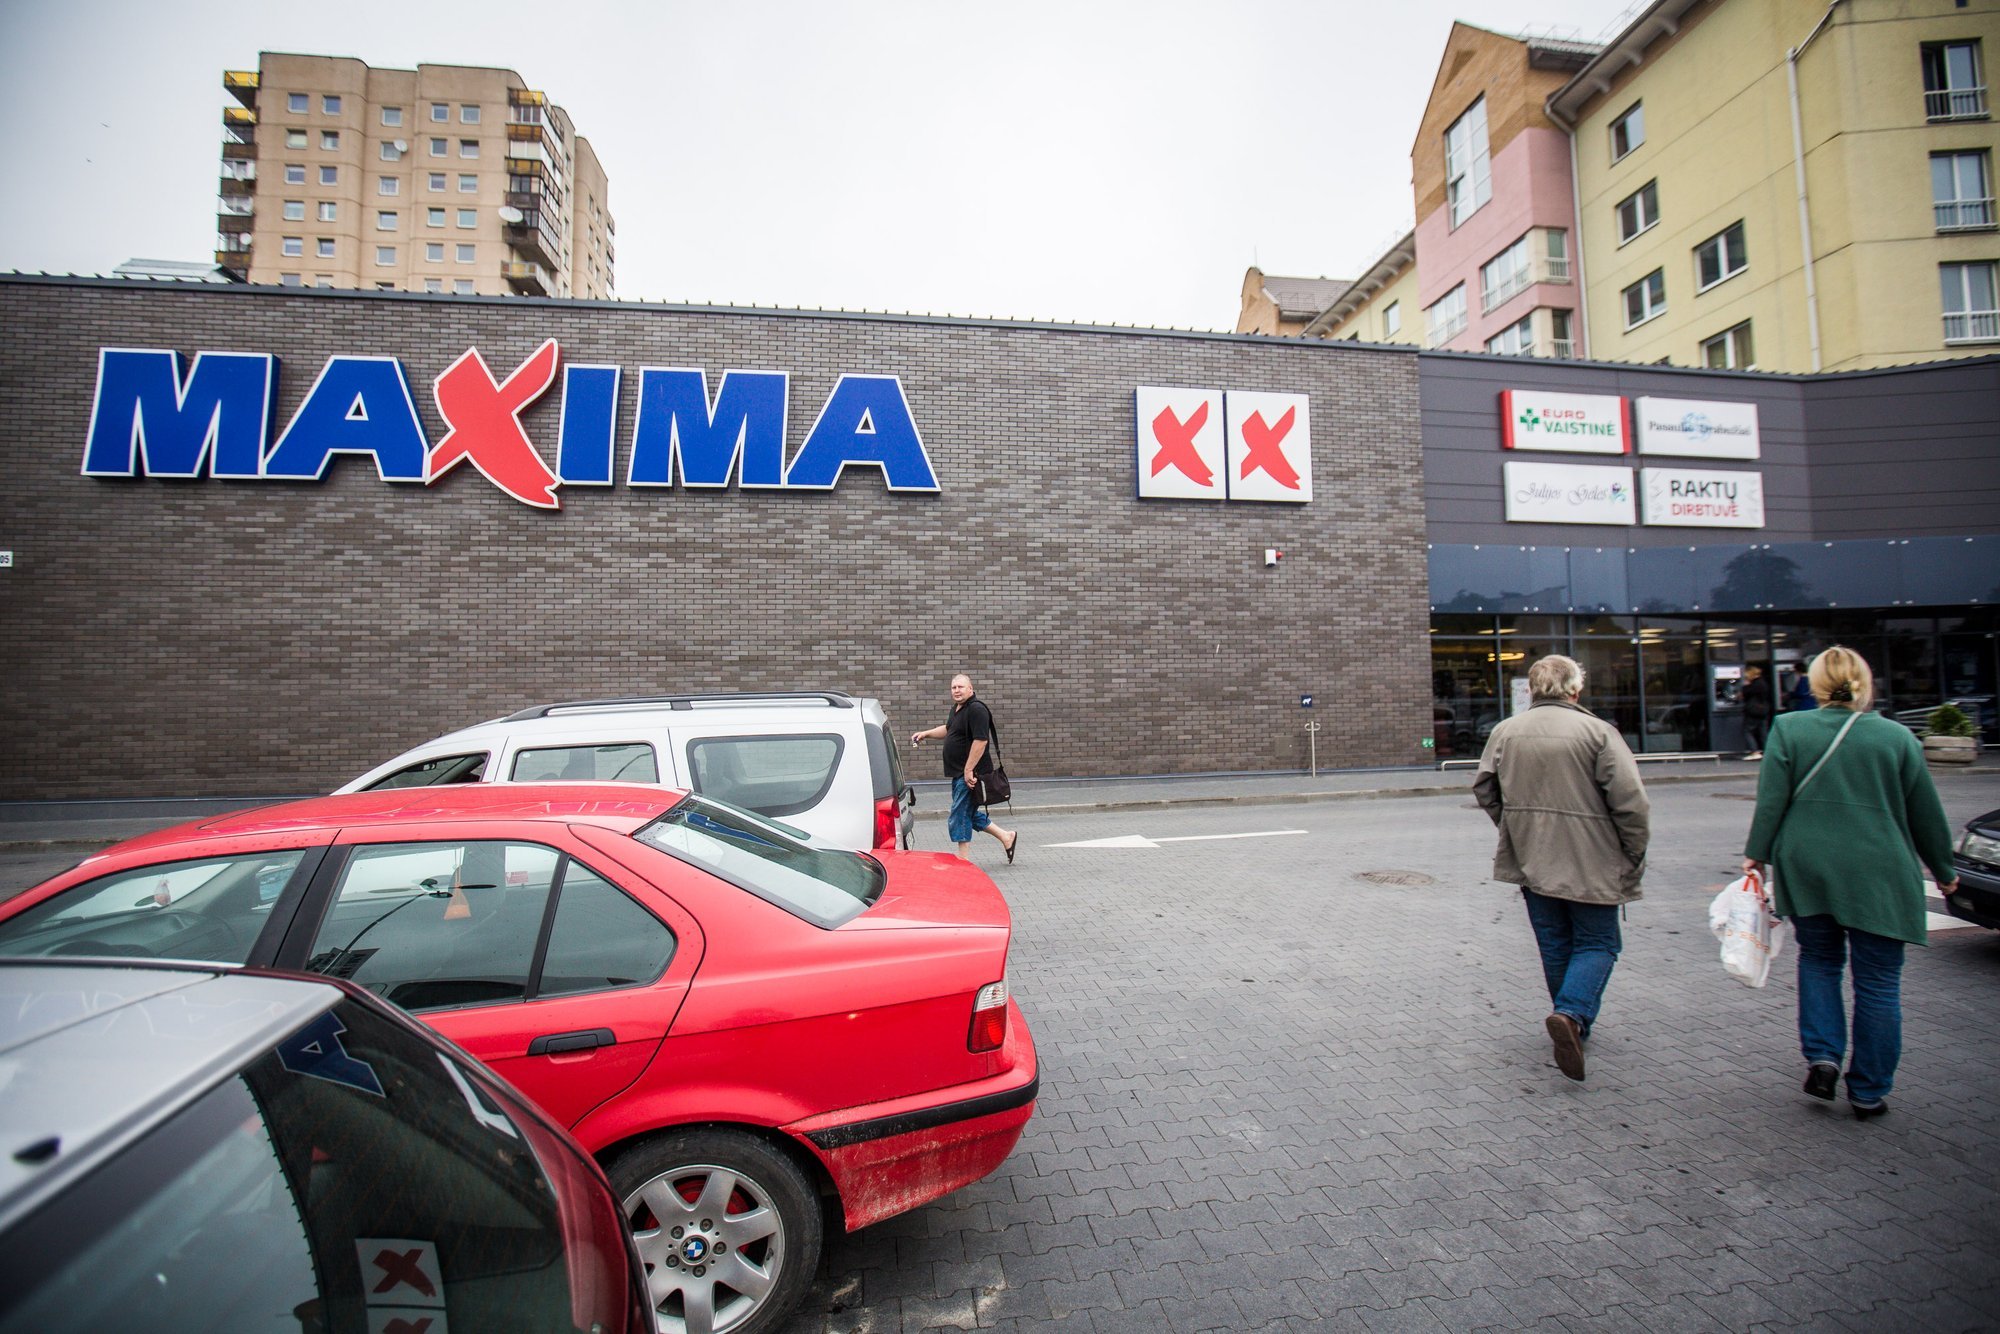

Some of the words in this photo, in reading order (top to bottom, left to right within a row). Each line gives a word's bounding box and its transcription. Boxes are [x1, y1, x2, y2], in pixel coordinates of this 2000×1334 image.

[81, 337, 941, 511] MAXIMA
[1543, 408, 1585, 419] EURO
[1670, 480, 1737, 503] RAKTŲ
